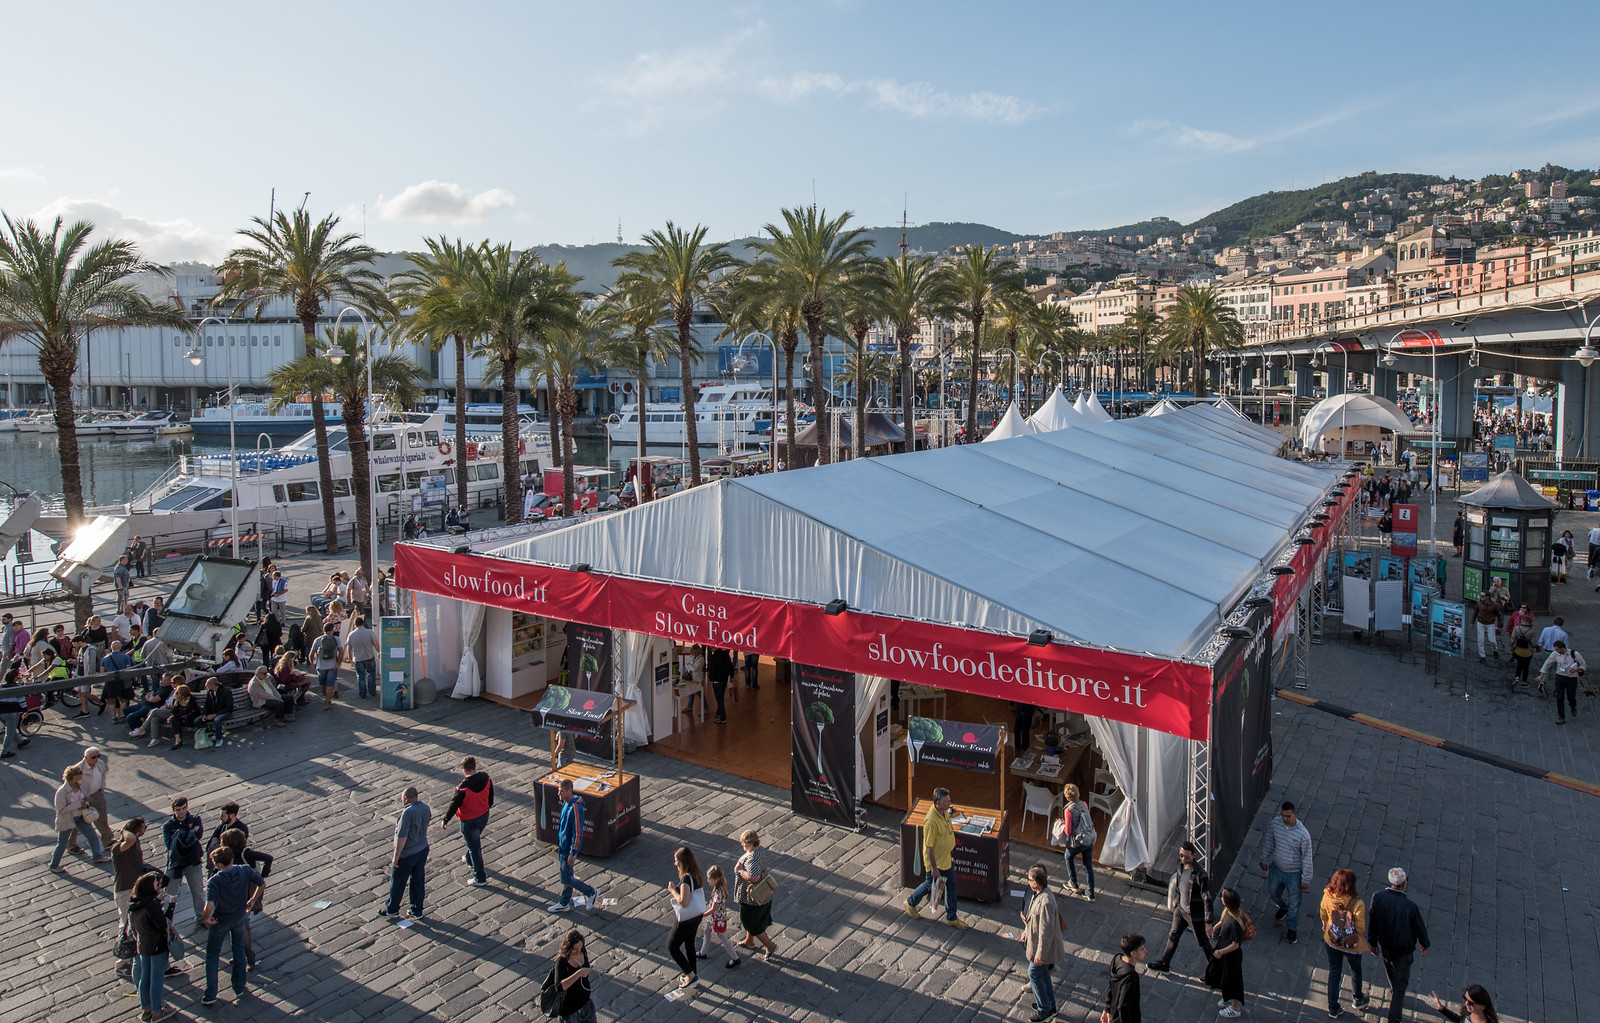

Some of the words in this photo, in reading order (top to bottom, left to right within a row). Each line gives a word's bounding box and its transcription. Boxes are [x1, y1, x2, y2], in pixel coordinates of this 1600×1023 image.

[443, 565, 548, 604] slowfood.it
[681, 593, 728, 620] Casa
[655, 611, 699, 638] Slow
[707, 619, 758, 648] Food
[868, 633, 1148, 708] slowfoodeditore.it
[566, 707, 584, 716] Slow
[583, 711, 602, 719] Food
[945, 740, 967, 749] Slow
[969, 744, 992, 753] Food
